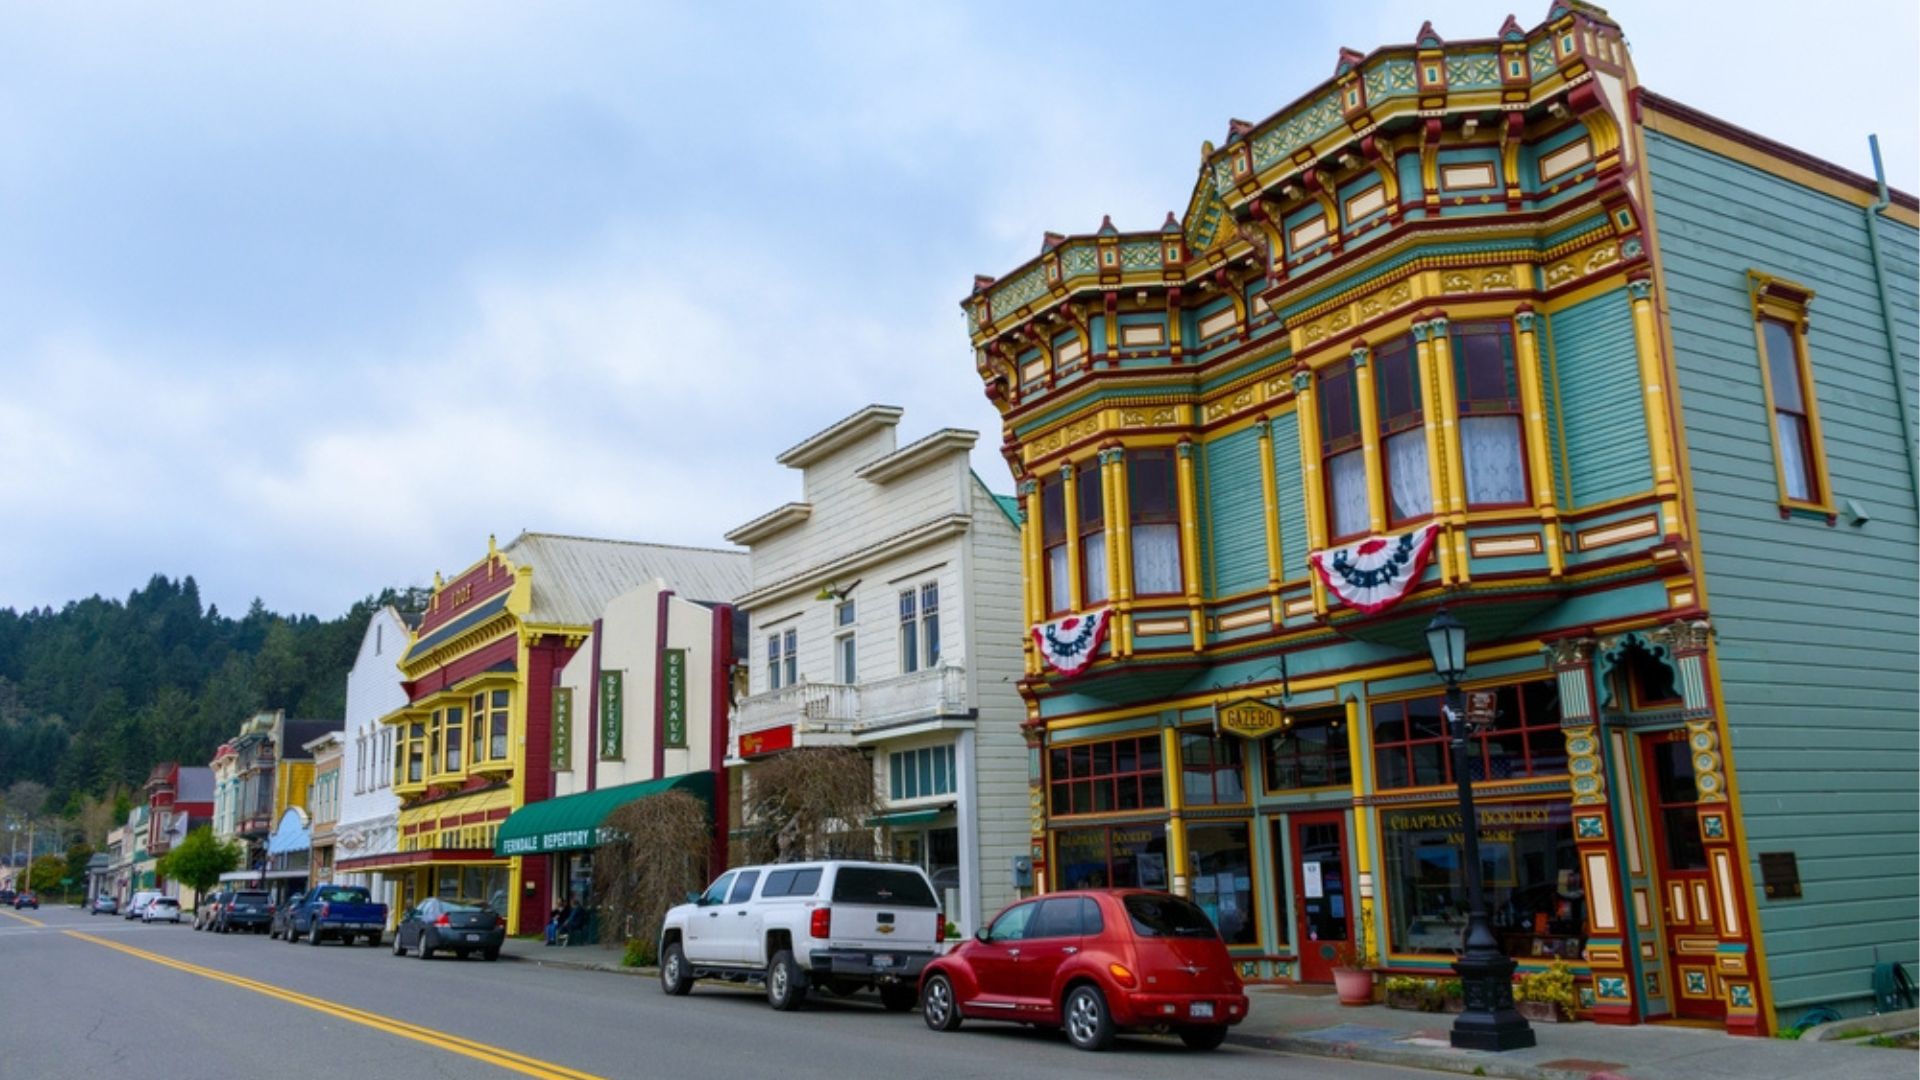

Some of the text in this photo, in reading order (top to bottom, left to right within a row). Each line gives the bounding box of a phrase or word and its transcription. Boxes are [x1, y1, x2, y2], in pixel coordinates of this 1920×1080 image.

[1227, 708, 1274, 727] GAZEBO
[503, 836, 538, 854] FERNDALE
[543, 829, 590, 849] REPERTORY
